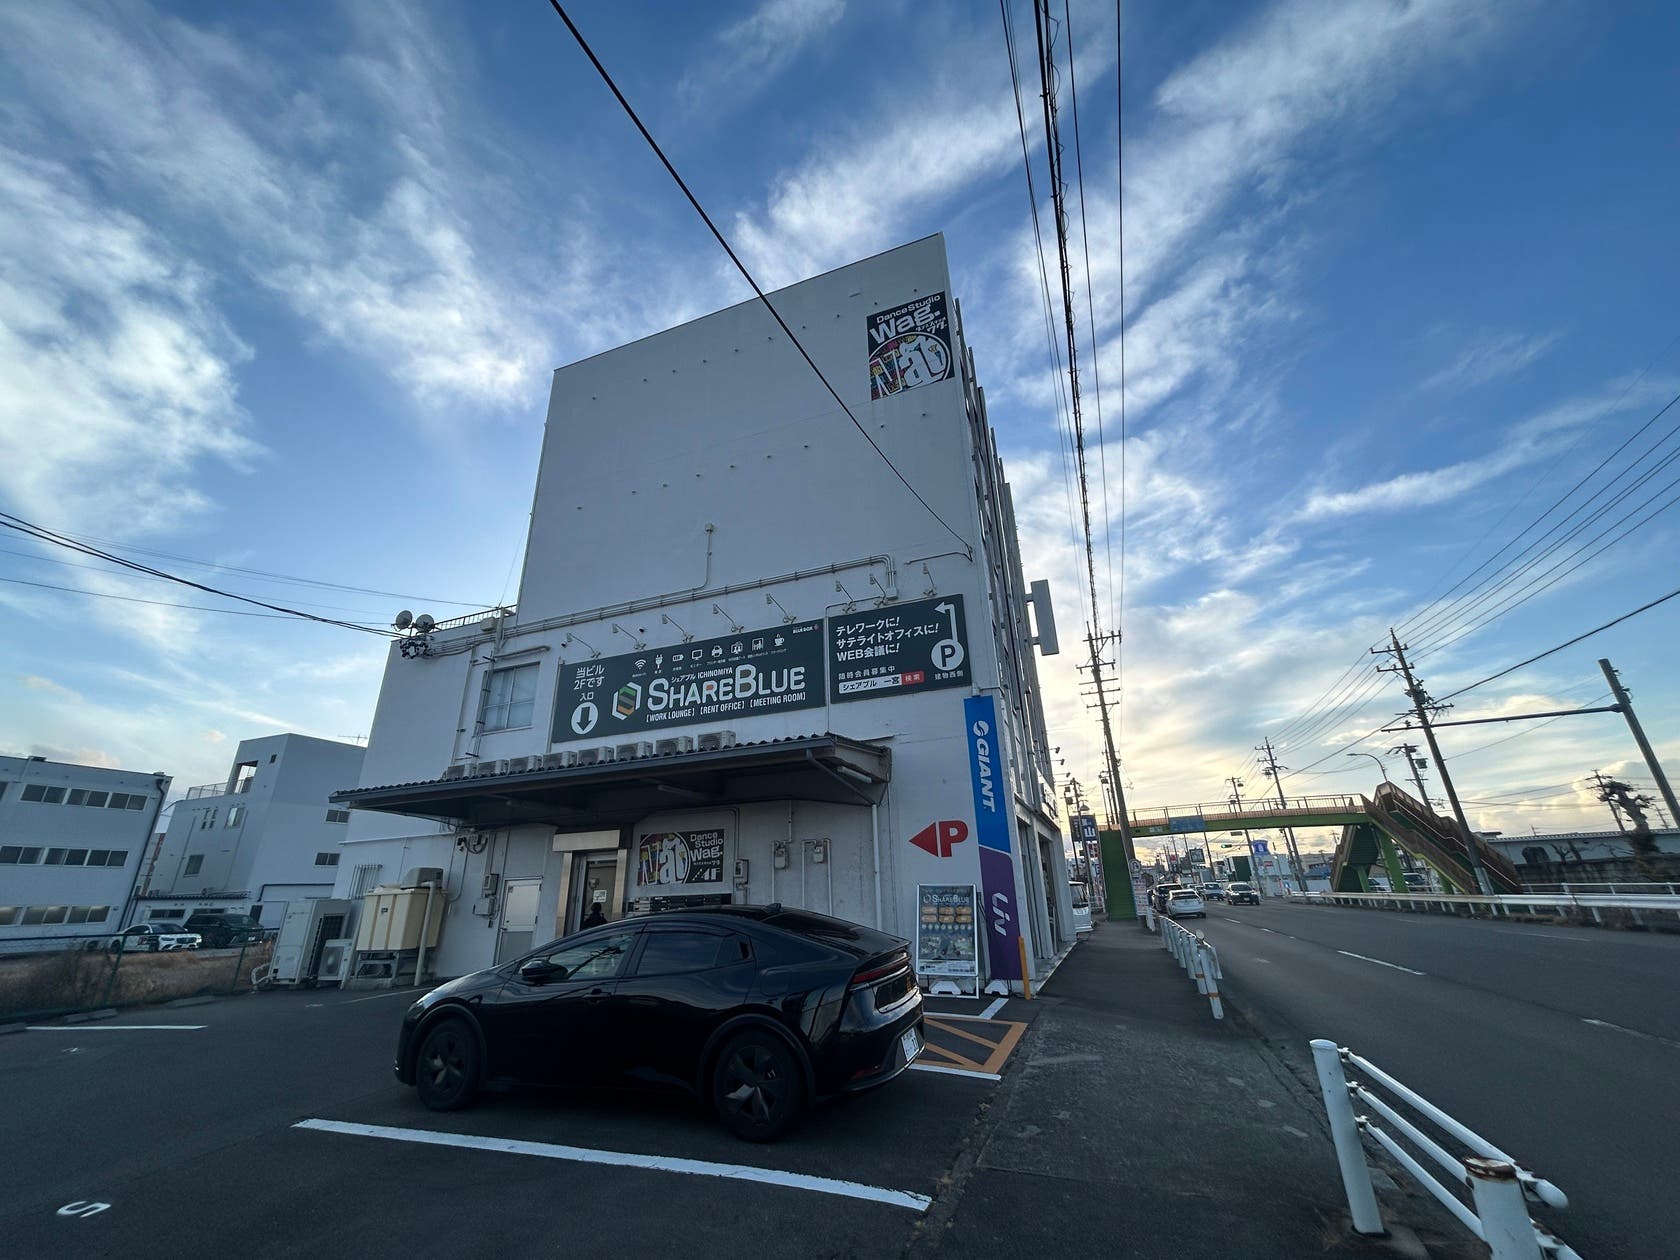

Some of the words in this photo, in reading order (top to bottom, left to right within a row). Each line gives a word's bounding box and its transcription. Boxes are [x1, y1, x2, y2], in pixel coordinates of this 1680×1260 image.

[836, 616, 900, 637] テレワークに!
[836, 623, 939, 649] サテライトオフィスに!
[836, 642, 900, 662] WEB会議に!
[940, 644, 956, 668] P
[575, 664, 605, 679] 当ビル
[697, 667, 733, 679] ICHINOMIYA
[573, 675, 605, 690] 2Fです
[579, 691, 594, 702] 入口
[976, 738, 996, 812] GIANT
[695, 838, 724, 848] Studio
[939, 820, 969, 858] P
